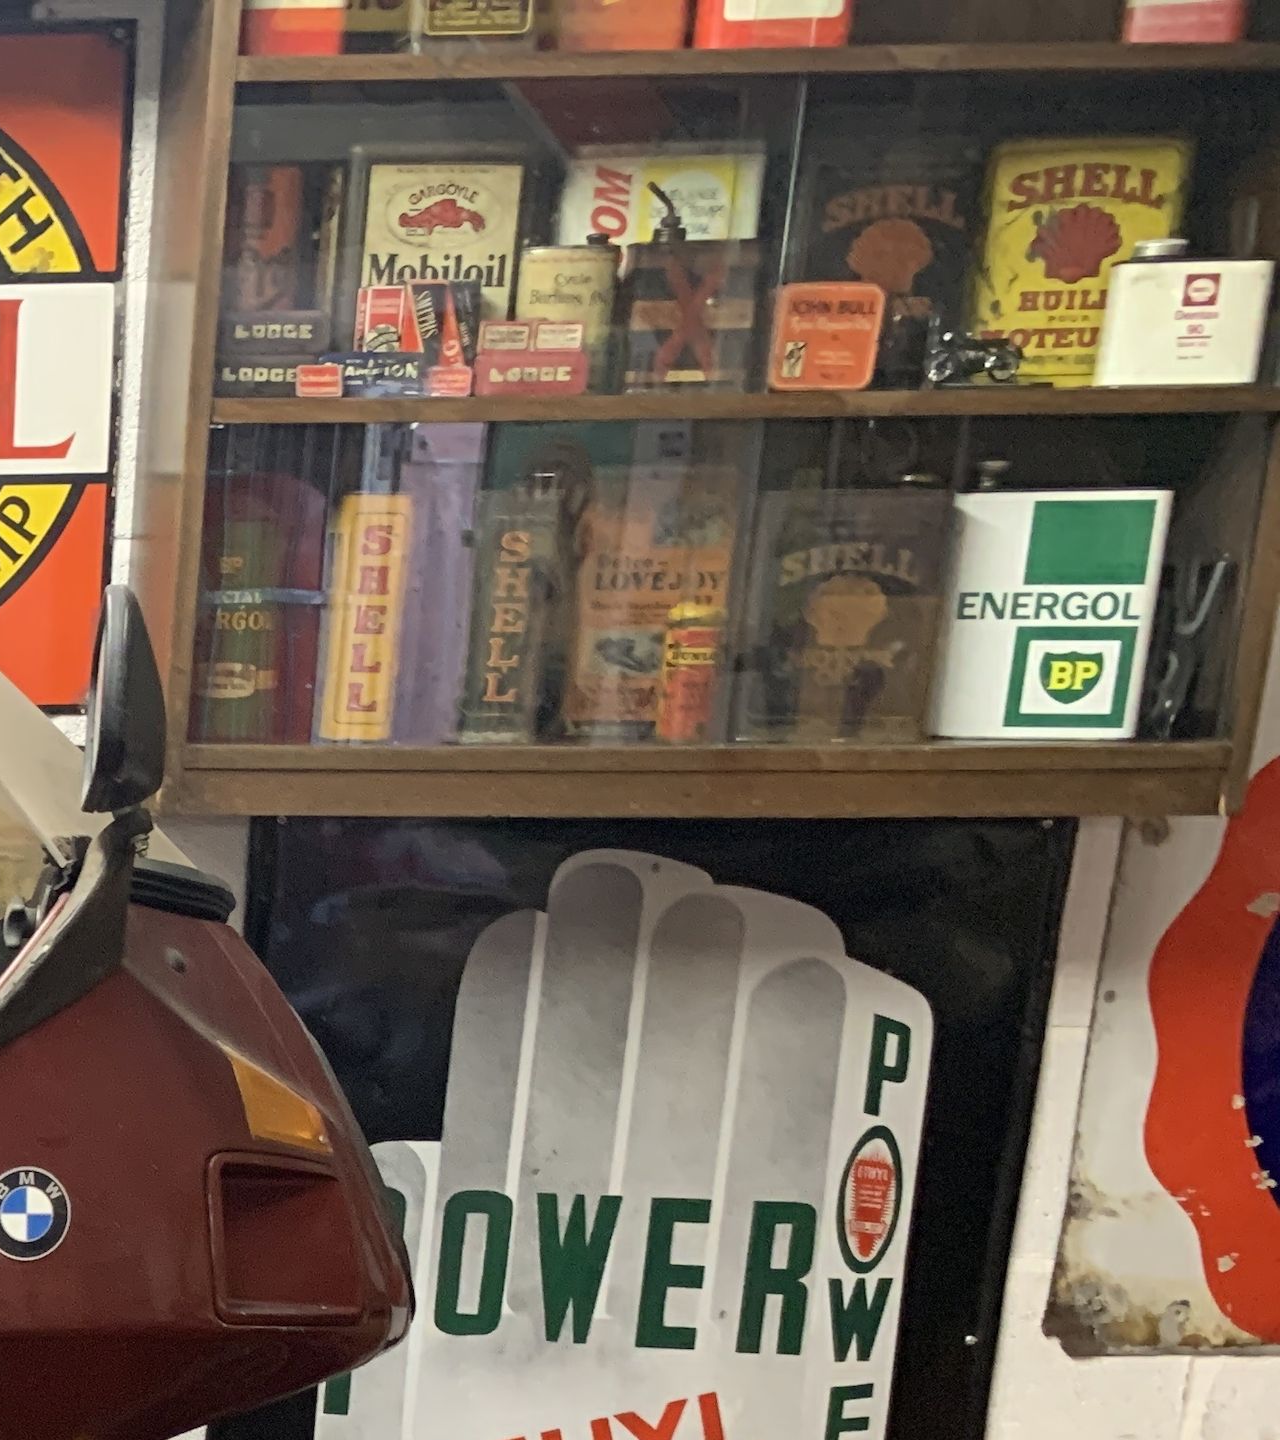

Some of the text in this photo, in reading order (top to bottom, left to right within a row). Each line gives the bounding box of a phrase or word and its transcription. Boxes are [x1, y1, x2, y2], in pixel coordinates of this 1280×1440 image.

[408, 183, 480, 206] GARGOYLE
[1008, 163, 1167, 212] SHELL
[1018, 289, 1106, 312] HUIL
[234, 323, 313, 340] LODGE
[1048, 314, 1090, 323] POUR
[489, 366, 572, 383] LODGE
[346, 524, 393, 712] SHELL
[481, 530, 531, 703] SHELL
[956, 591, 1141, 621] ENERGOL
[1046, 660, 1100, 691] BP
[323, 1186, 819, 1415] OWER
